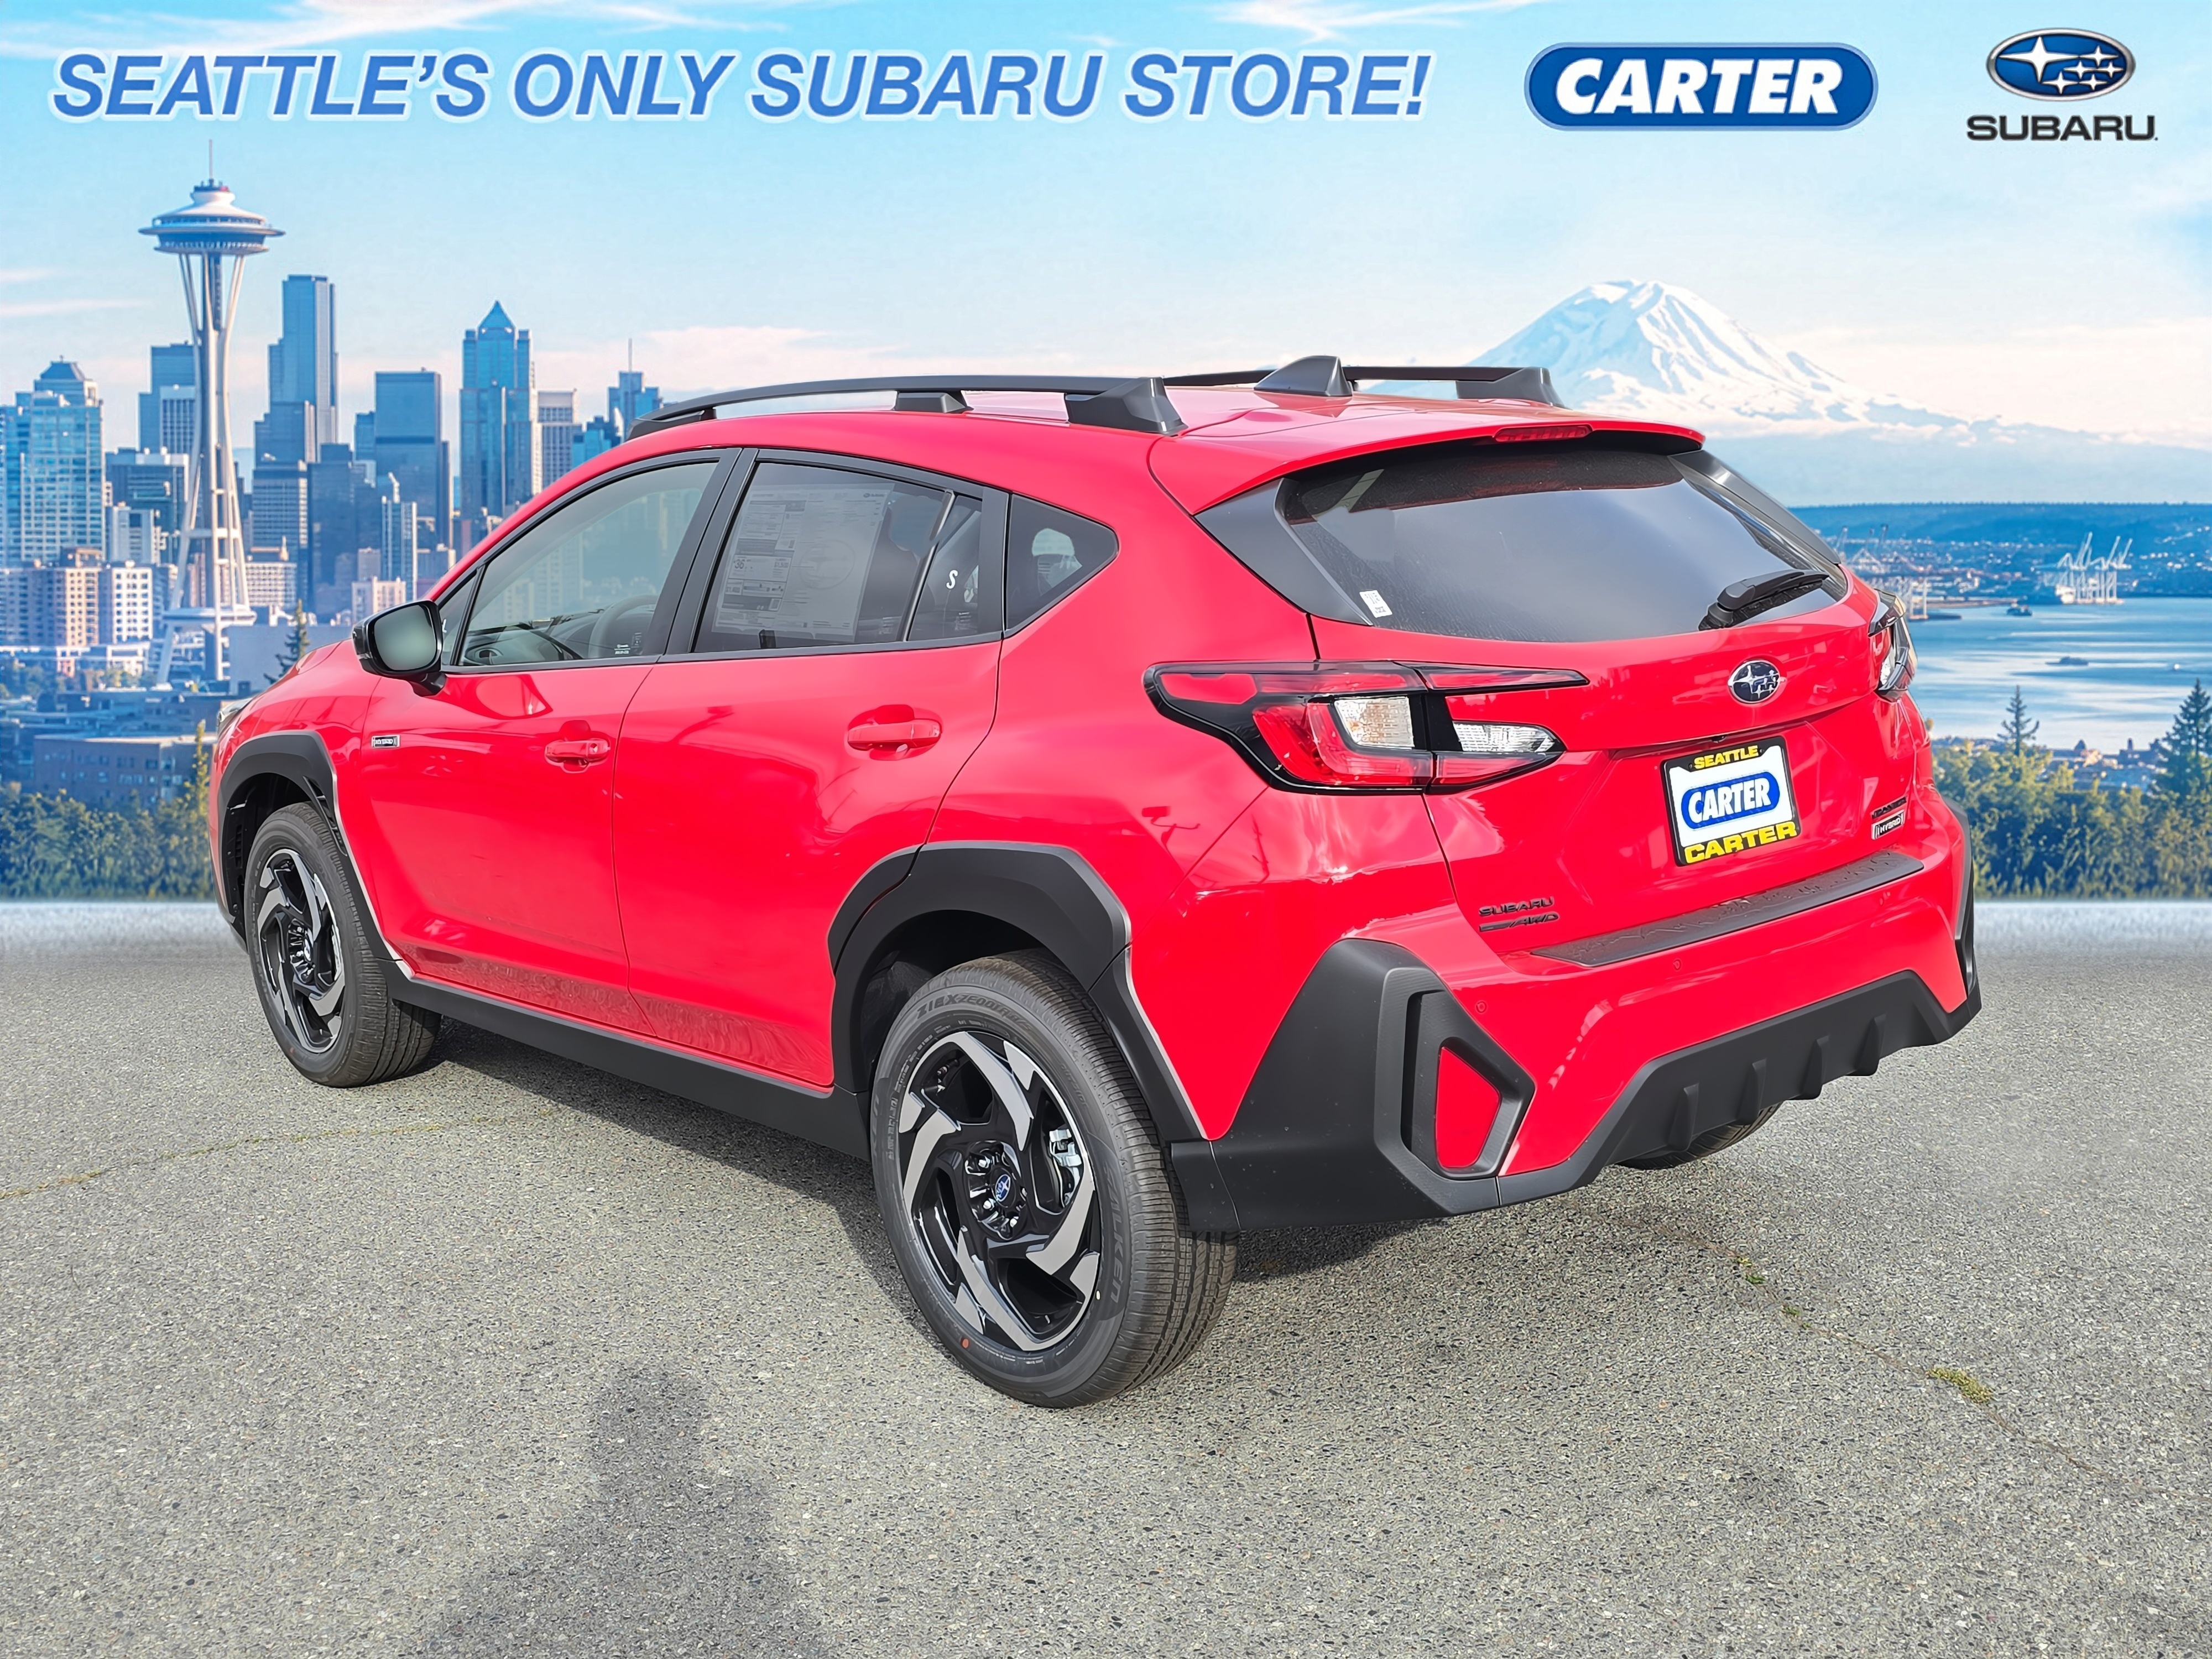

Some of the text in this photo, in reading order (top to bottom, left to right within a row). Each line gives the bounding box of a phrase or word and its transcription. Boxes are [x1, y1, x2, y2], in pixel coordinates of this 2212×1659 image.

[1693, 744, 1760, 770] SEATTLE
[1687, 777, 1772, 824] CARTER
[1684, 821, 1798, 864] CARTER
[1478, 896, 1555, 917] SUBARU
[1513, 911, 1559, 926] AWD
